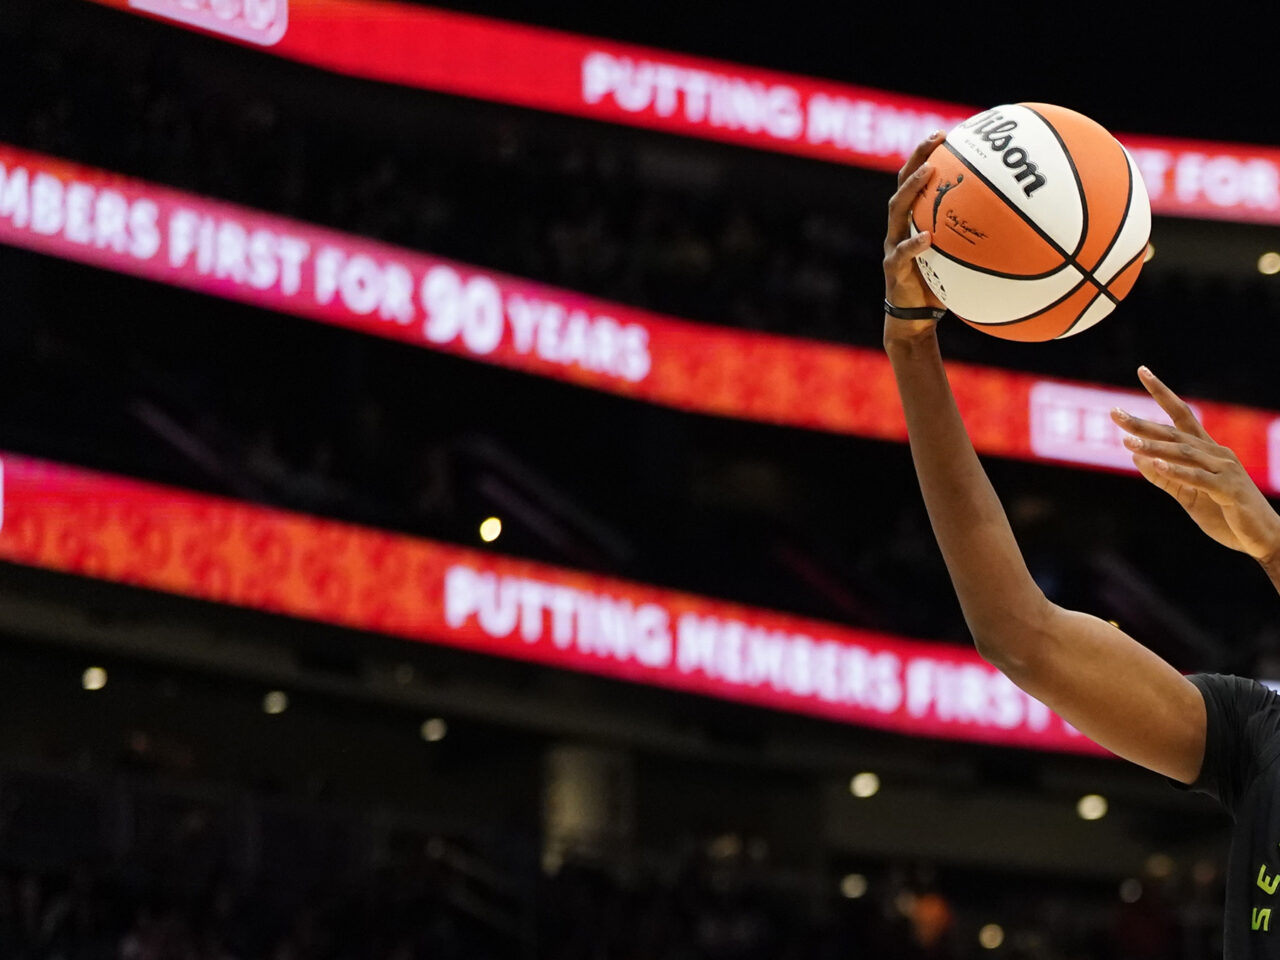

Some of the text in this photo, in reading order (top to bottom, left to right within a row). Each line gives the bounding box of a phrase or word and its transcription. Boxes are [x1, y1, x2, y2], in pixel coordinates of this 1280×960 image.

[582, 52, 803, 138] PUTTING
[806, 92, 966, 163] MEMB
[1174, 151, 1280, 211] FOR
[168, 207, 310, 297] FIRST
[314, 246, 416, 326] FOR
[421, 264, 503, 356] 90
[507, 292, 652, 383] YEARS
[445, 564, 673, 669] PUTTING
[676, 611, 901, 714] MEMBERS
